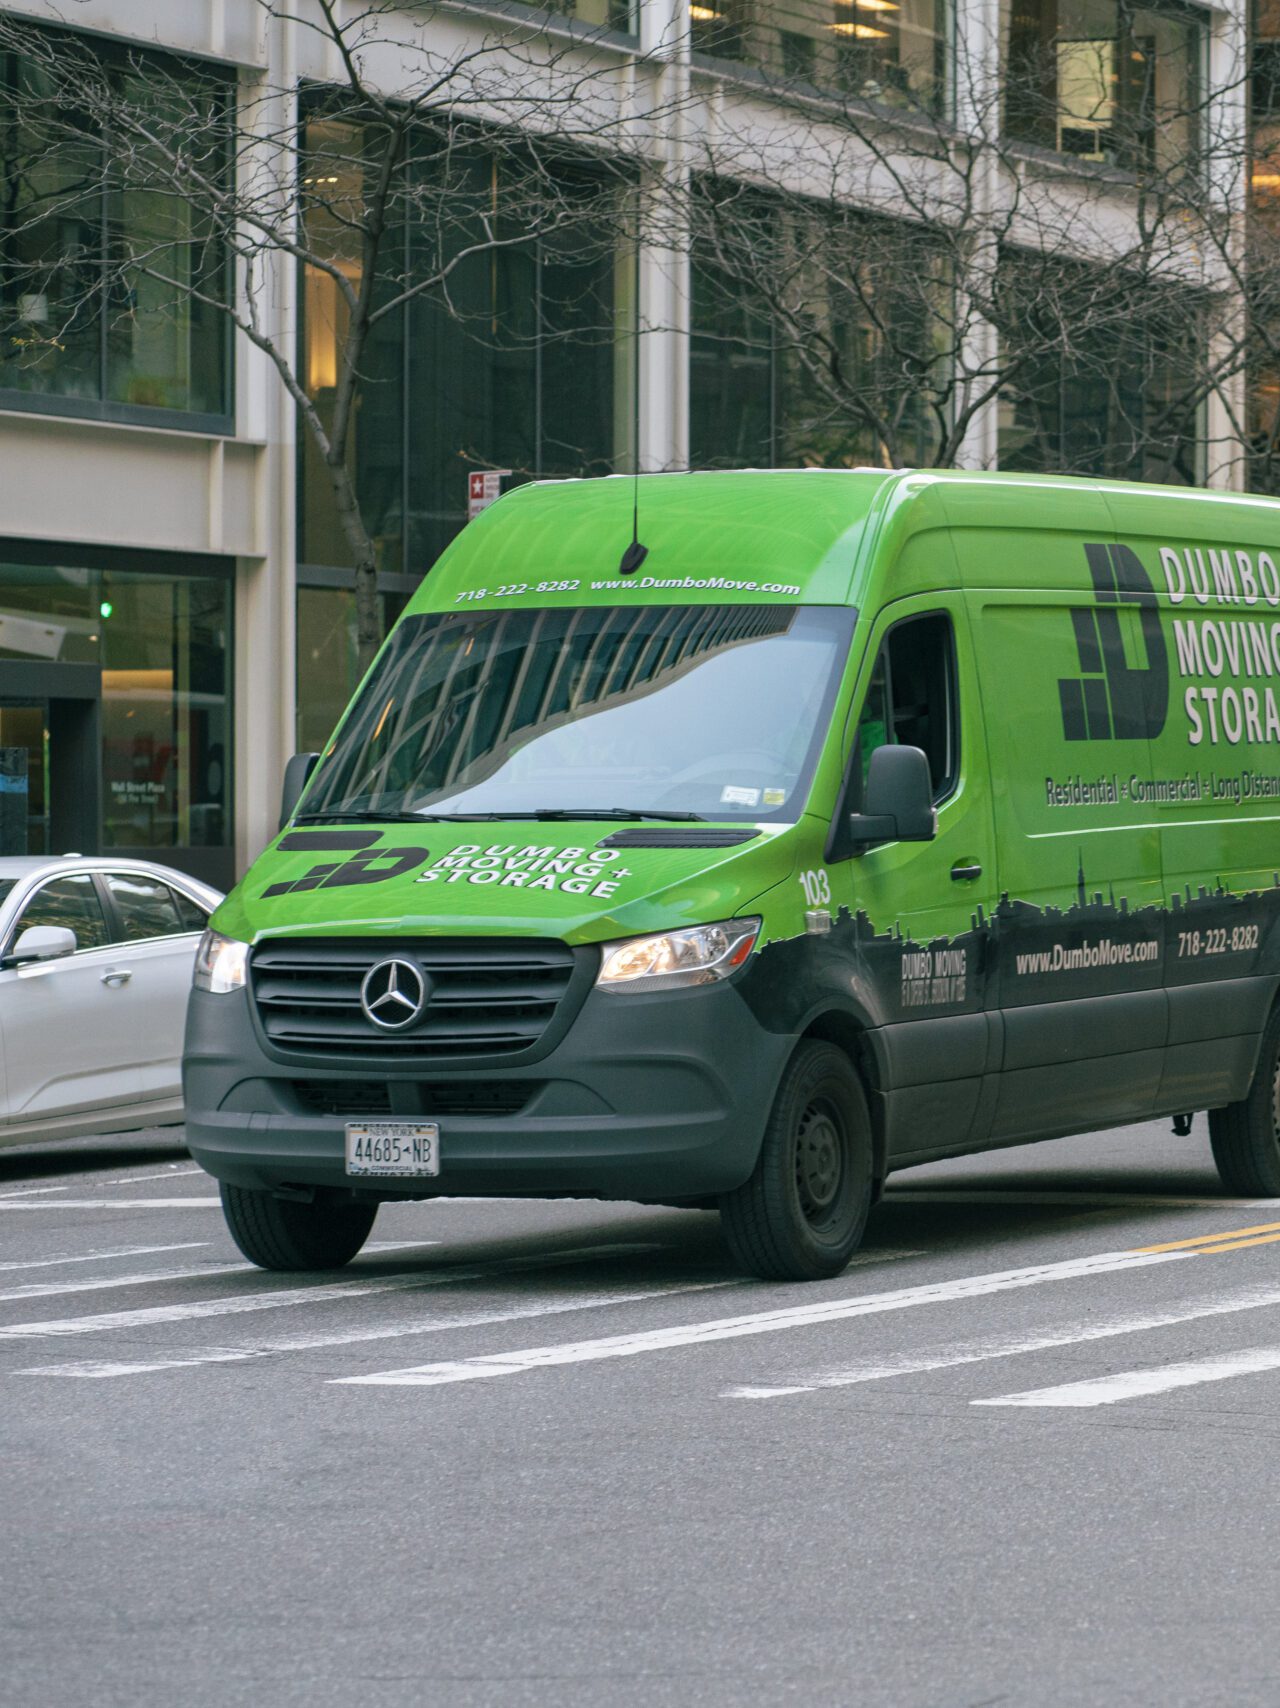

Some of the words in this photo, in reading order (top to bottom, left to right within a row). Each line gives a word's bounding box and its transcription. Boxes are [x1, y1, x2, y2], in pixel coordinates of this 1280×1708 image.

[455, 579, 580, 603] 718-222-8282
[590, 576, 800, 595] www.DumboMove.com
[1159, 547, 1280, 606] DUMBO
[1046, 773, 1119, 806] Residential
[1130, 771, 1202, 803] Commercial
[1211, 771, 1242, 806] Long
[446, 844, 621, 862] DUMBO
[414, 868, 621, 899] STORAGE
[799, 868, 831, 906] 103
[901, 952, 932, 980] DUMBO
[935, 949, 966, 976] MOVING
[1016, 939, 1158, 975] www.DumboMove.com
[1178, 925, 1260, 957] 718-222-8282
